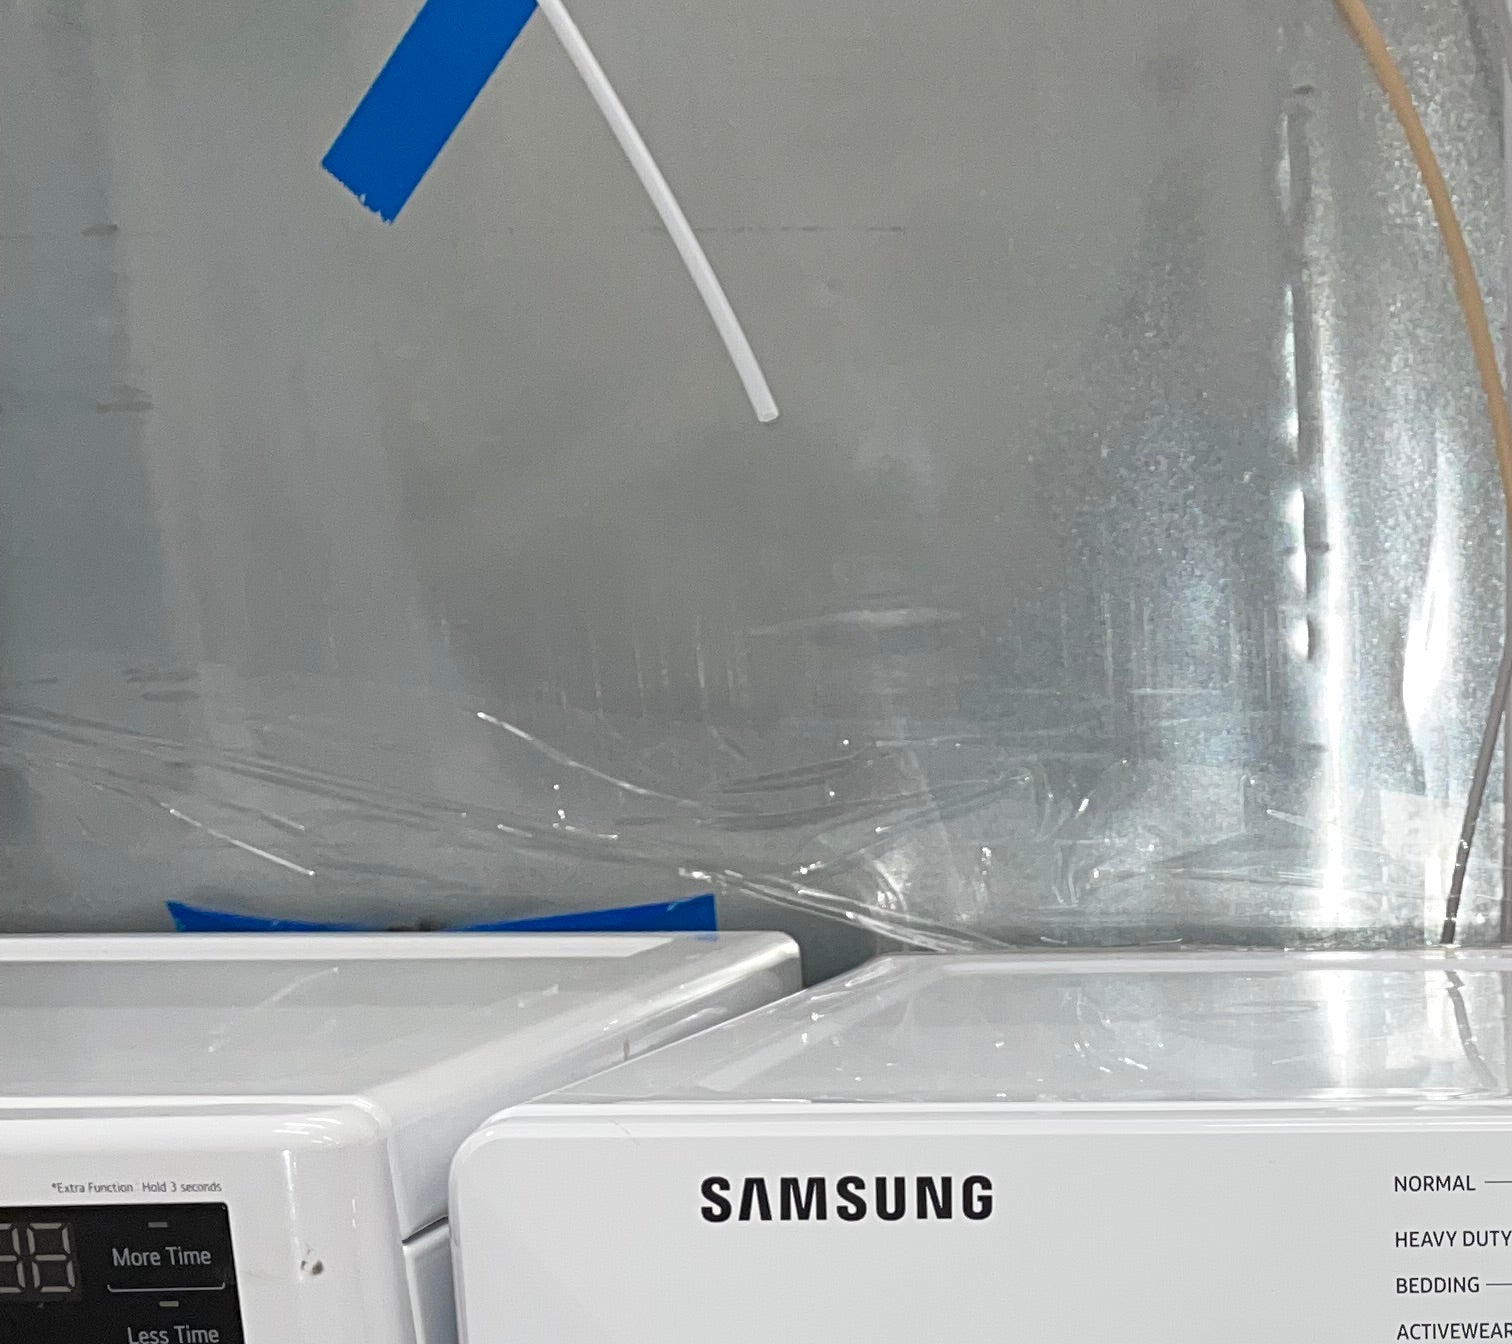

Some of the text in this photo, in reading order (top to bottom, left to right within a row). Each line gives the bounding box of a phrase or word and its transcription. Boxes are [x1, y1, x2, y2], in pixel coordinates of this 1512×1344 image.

[1394, 1175, 1476, 1193] NORMAL
[700, 1175, 993, 1223] SAMSUNG
[1395, 1230, 1512, 1248] HEAVY DUTY
[111, 1246, 212, 1267] More Time
[1396, 1276, 1480, 1294] BEDDING
[173, 1324, 220, 1344] Time
